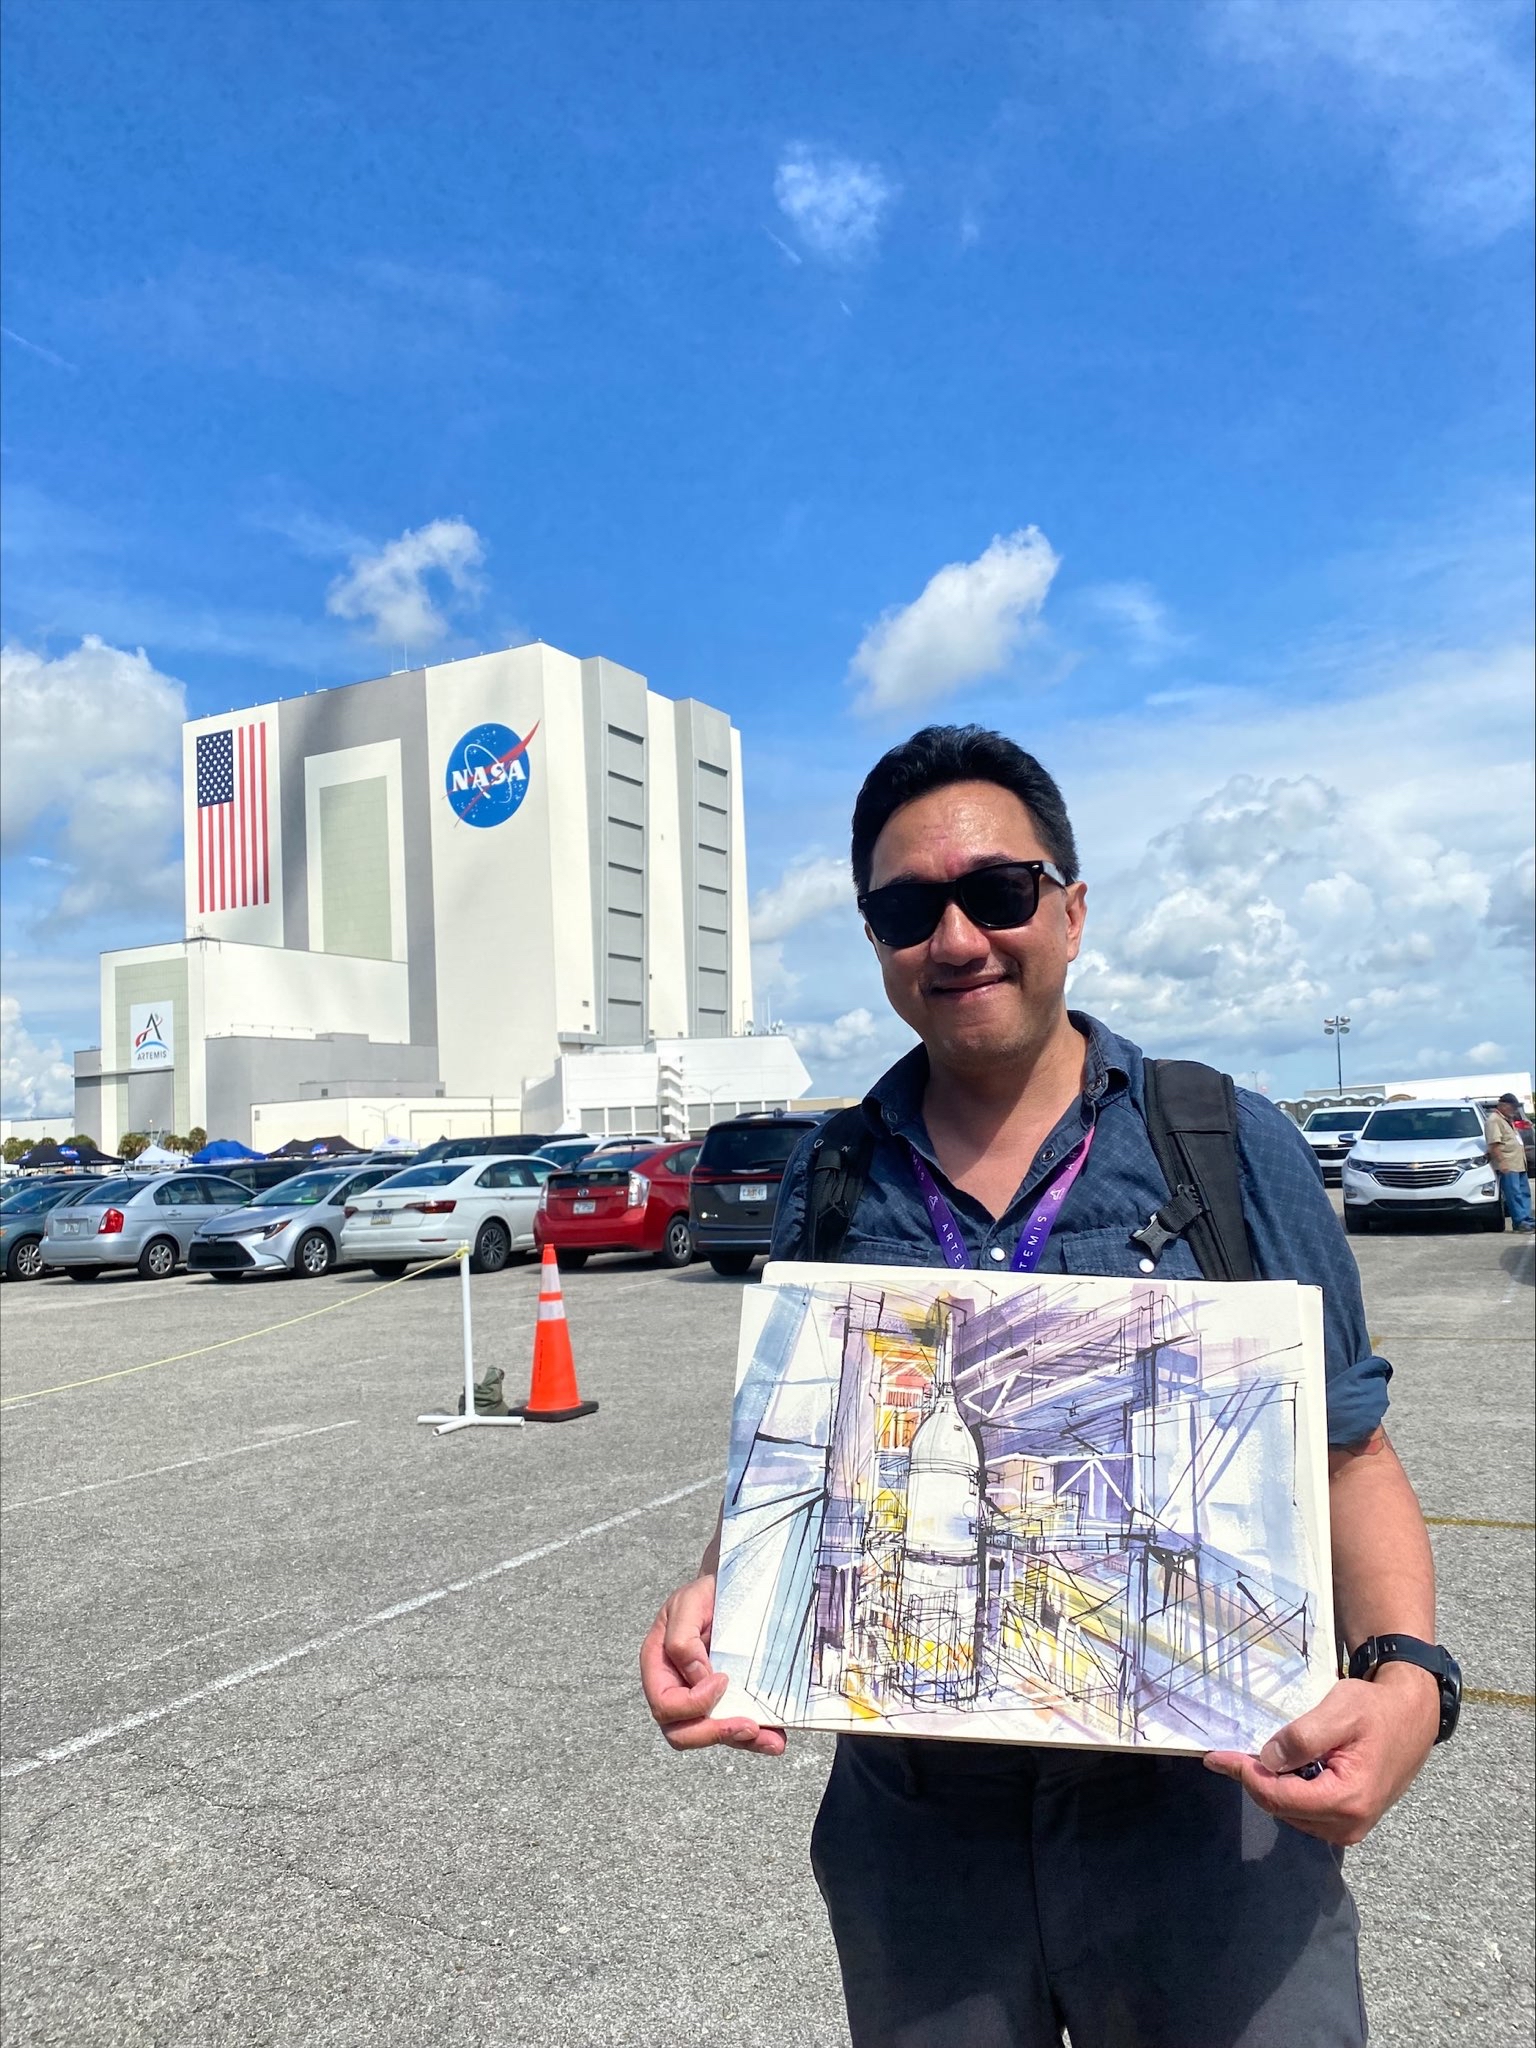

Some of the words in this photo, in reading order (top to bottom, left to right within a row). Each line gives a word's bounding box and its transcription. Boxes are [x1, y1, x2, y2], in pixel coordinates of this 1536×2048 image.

[451, 759, 527, 792] NASA
[137, 1050, 167, 1061] ARTEMIS
[942, 1223, 966, 1269] ARTE
[1018, 1215, 1047, 1269] TEMIS
